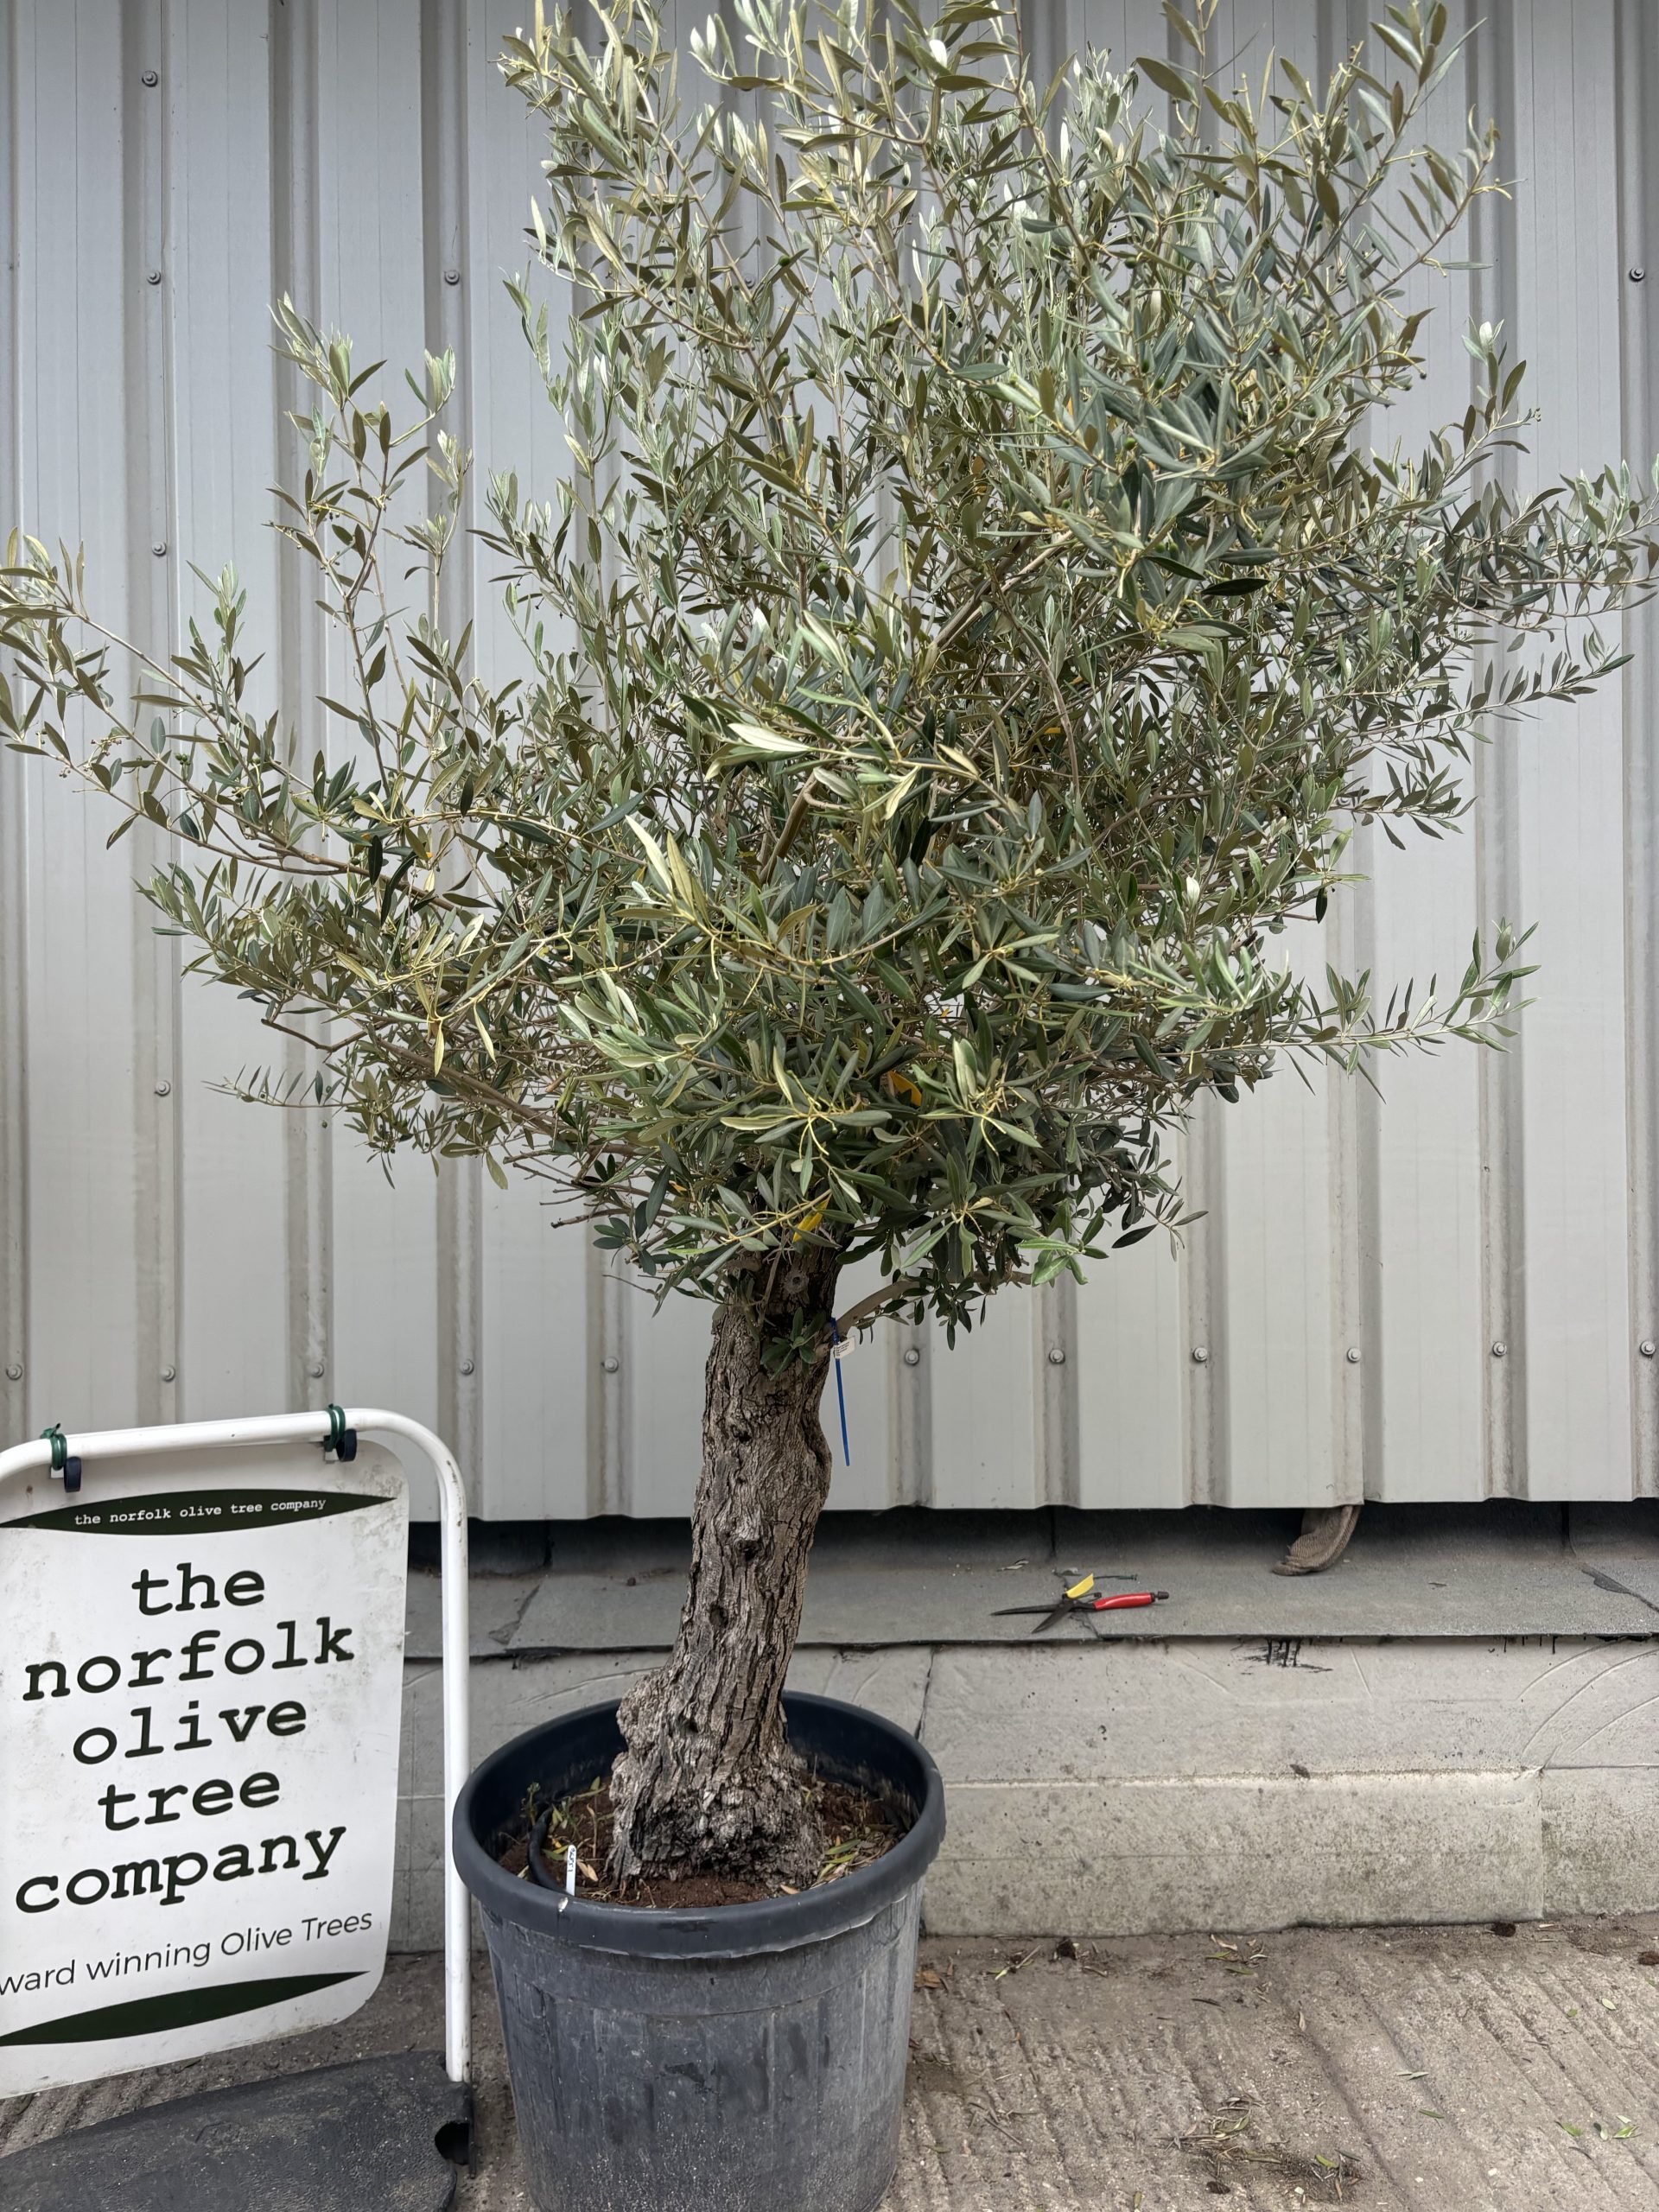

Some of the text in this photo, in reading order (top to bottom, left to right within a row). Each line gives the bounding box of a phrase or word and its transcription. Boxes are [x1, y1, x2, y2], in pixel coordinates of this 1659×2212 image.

[74, 1499, 327, 1525] the norfolk olive tree company
[131, 1562, 265, 1616] the
[22, 1616, 355, 1701] norfolk
[73, 1700, 307, 1765] olive
[98, 1771, 280, 1831] tree
[16, 1826, 346, 1914] company
[86, 1942, 211, 1980] winning
[220, 1928, 292, 1955] Olive
[301, 1912, 372, 1942] Trees
